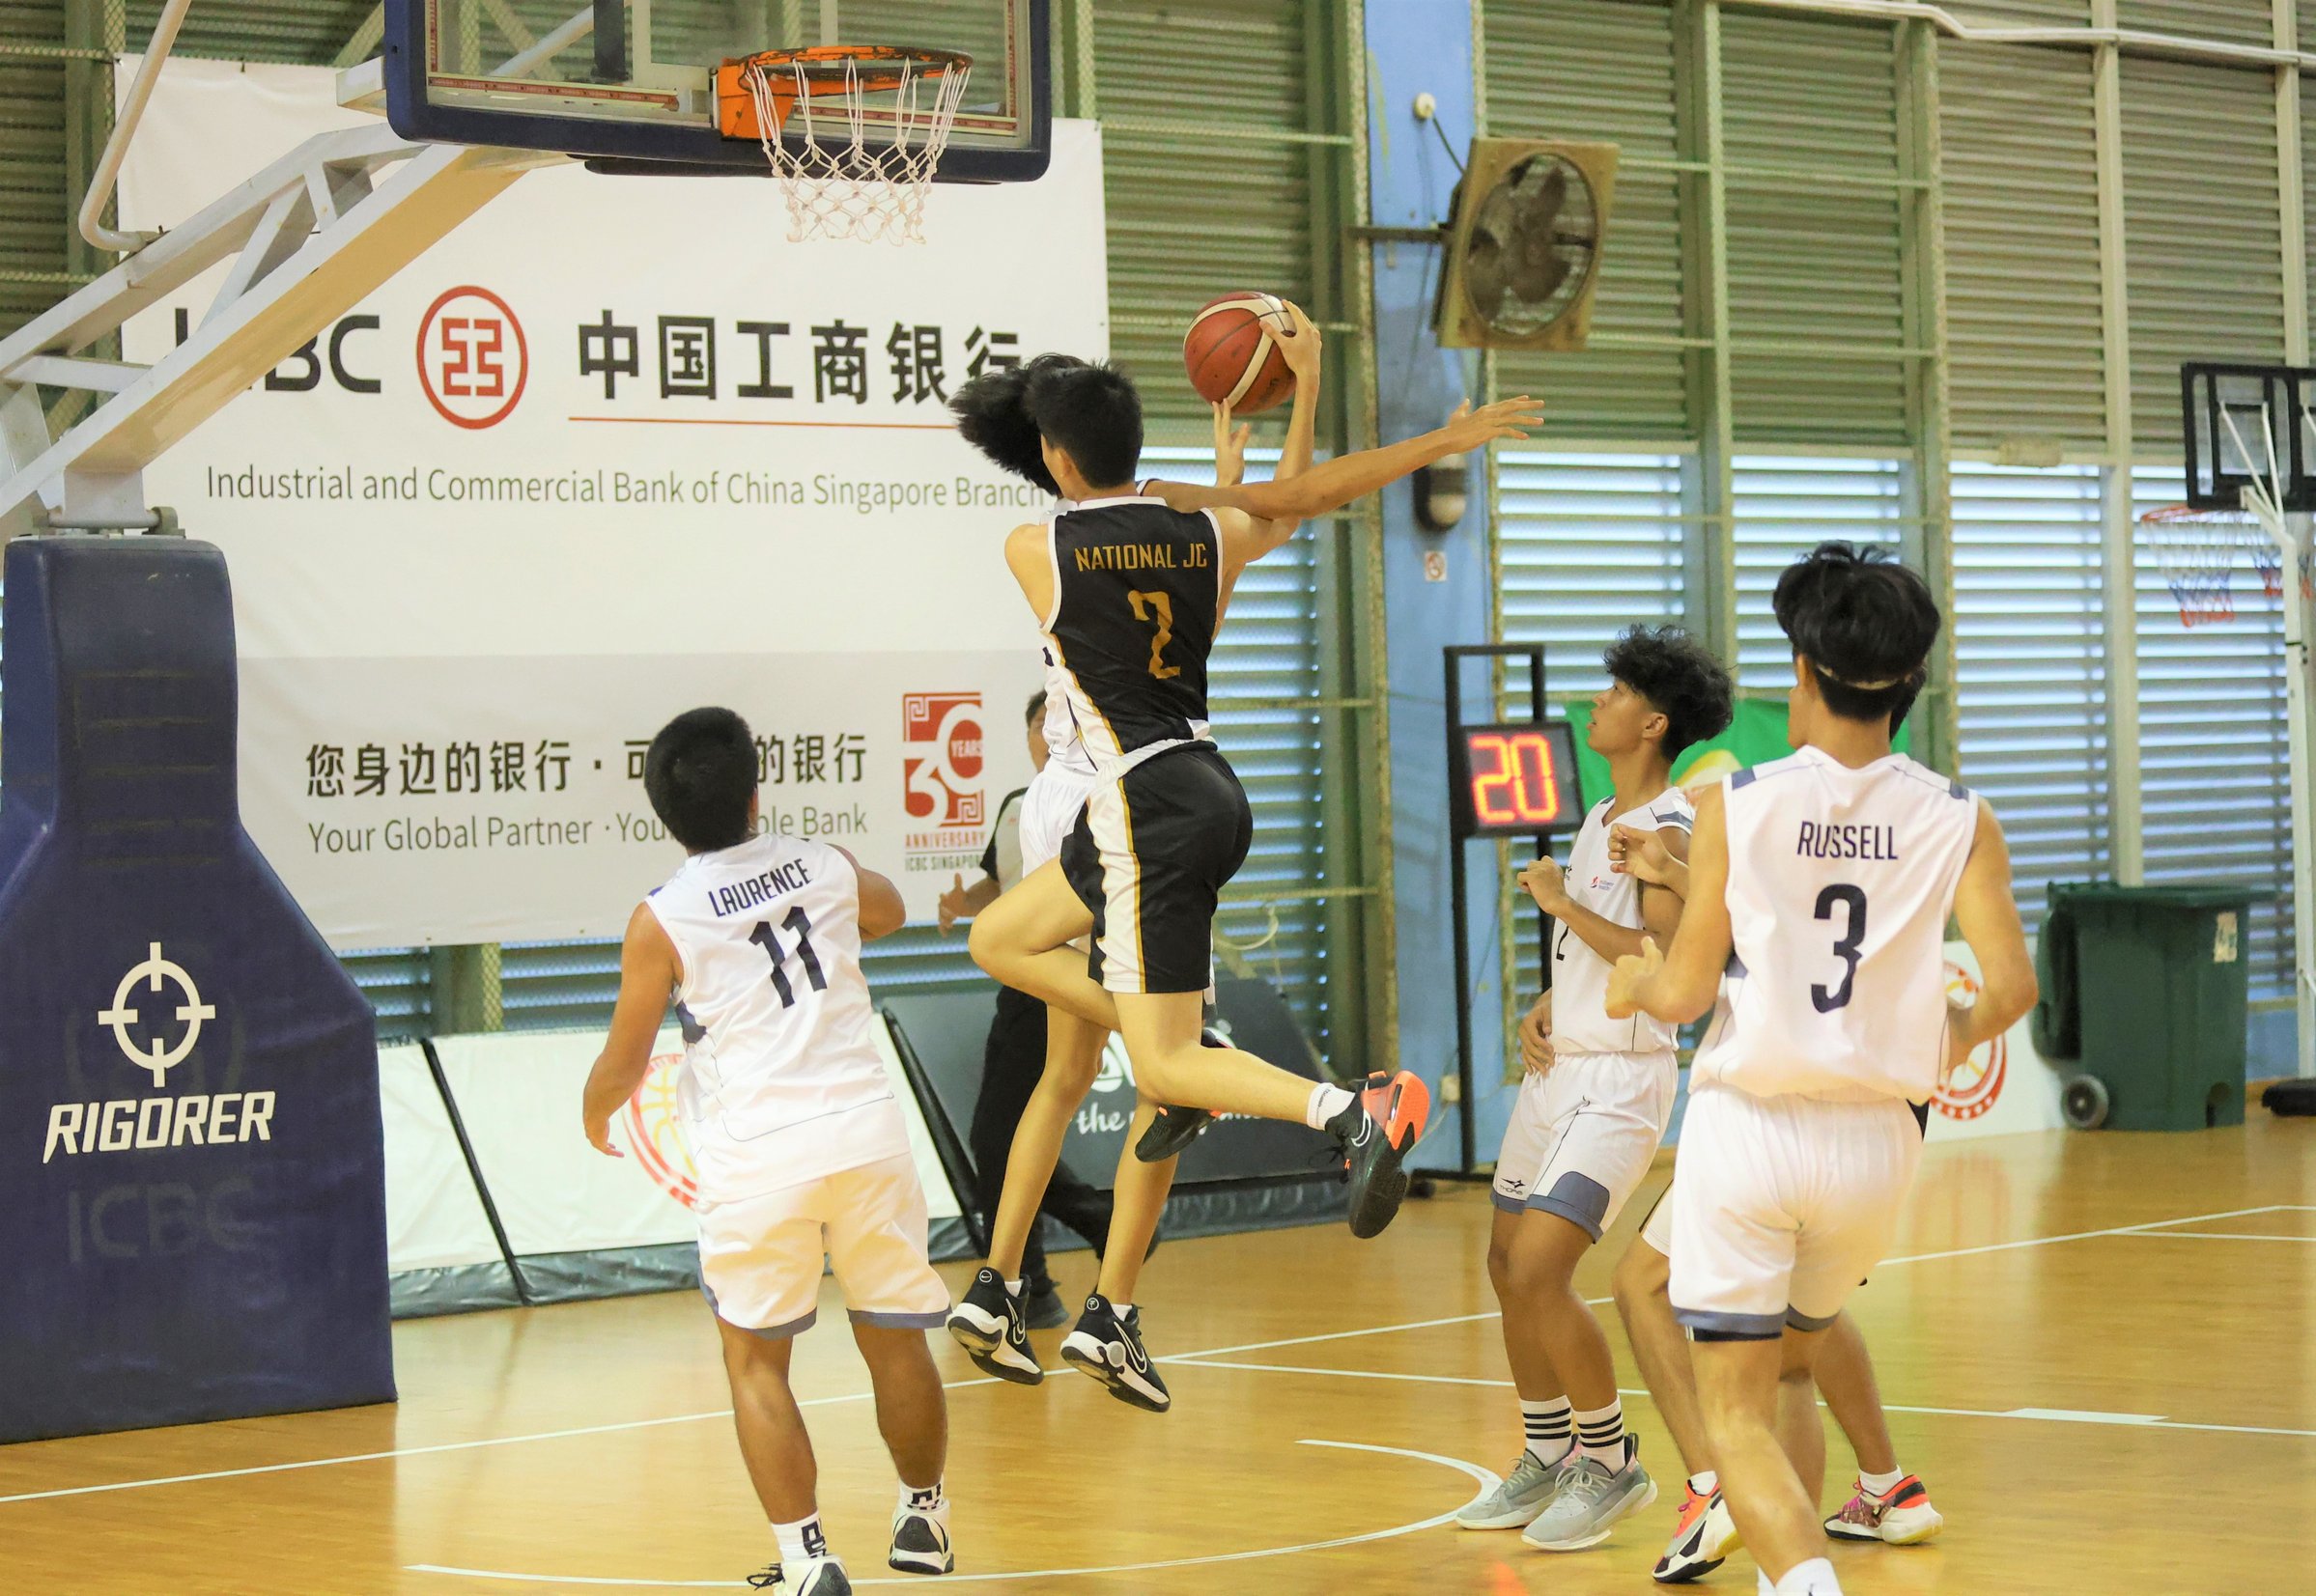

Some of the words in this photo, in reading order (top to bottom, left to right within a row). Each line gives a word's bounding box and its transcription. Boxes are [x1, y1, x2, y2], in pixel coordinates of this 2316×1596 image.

[176, 308, 381, 393] IBC
[578, 309, 1021, 405] 中国工商银行
[209, 463, 353, 499] Industrial
[363, 466, 417, 500] and
[429, 469, 604, 502] Commercial
[614, 471, 684, 502] Bank
[692, 471, 719, 503] of
[727, 472, 804, 504] China
[814, 474, 946, 514] Singapore
[956, 477, 1043, 507] Branch
[1075, 544, 1176, 572] NATIONAL
[1183, 543, 1207, 568] JC
[1127, 589, 1181, 680] 2
[951, 740, 983, 758] YEARS
[1469, 733, 1560, 824] 20
[308, 823, 376, 854] Your
[384, 816, 477, 851] Global
[488, 816, 592, 847] Partner
[803, 803, 866, 835] Bank
[905, 831, 985, 848] ANNIVERSARY
[1797, 821, 1898, 859] RUSSELL
[708, 858, 813, 917] LAURENCE
[931, 854, 981, 871] SINGAPOR
[748, 906, 828, 1009] 11
[1811, 883, 1867, 1014] 3
[42, 1090, 275, 1163] RIGORER
[1077, 1103, 1126, 1134] the
[69, 1175, 263, 1263] ICBC
